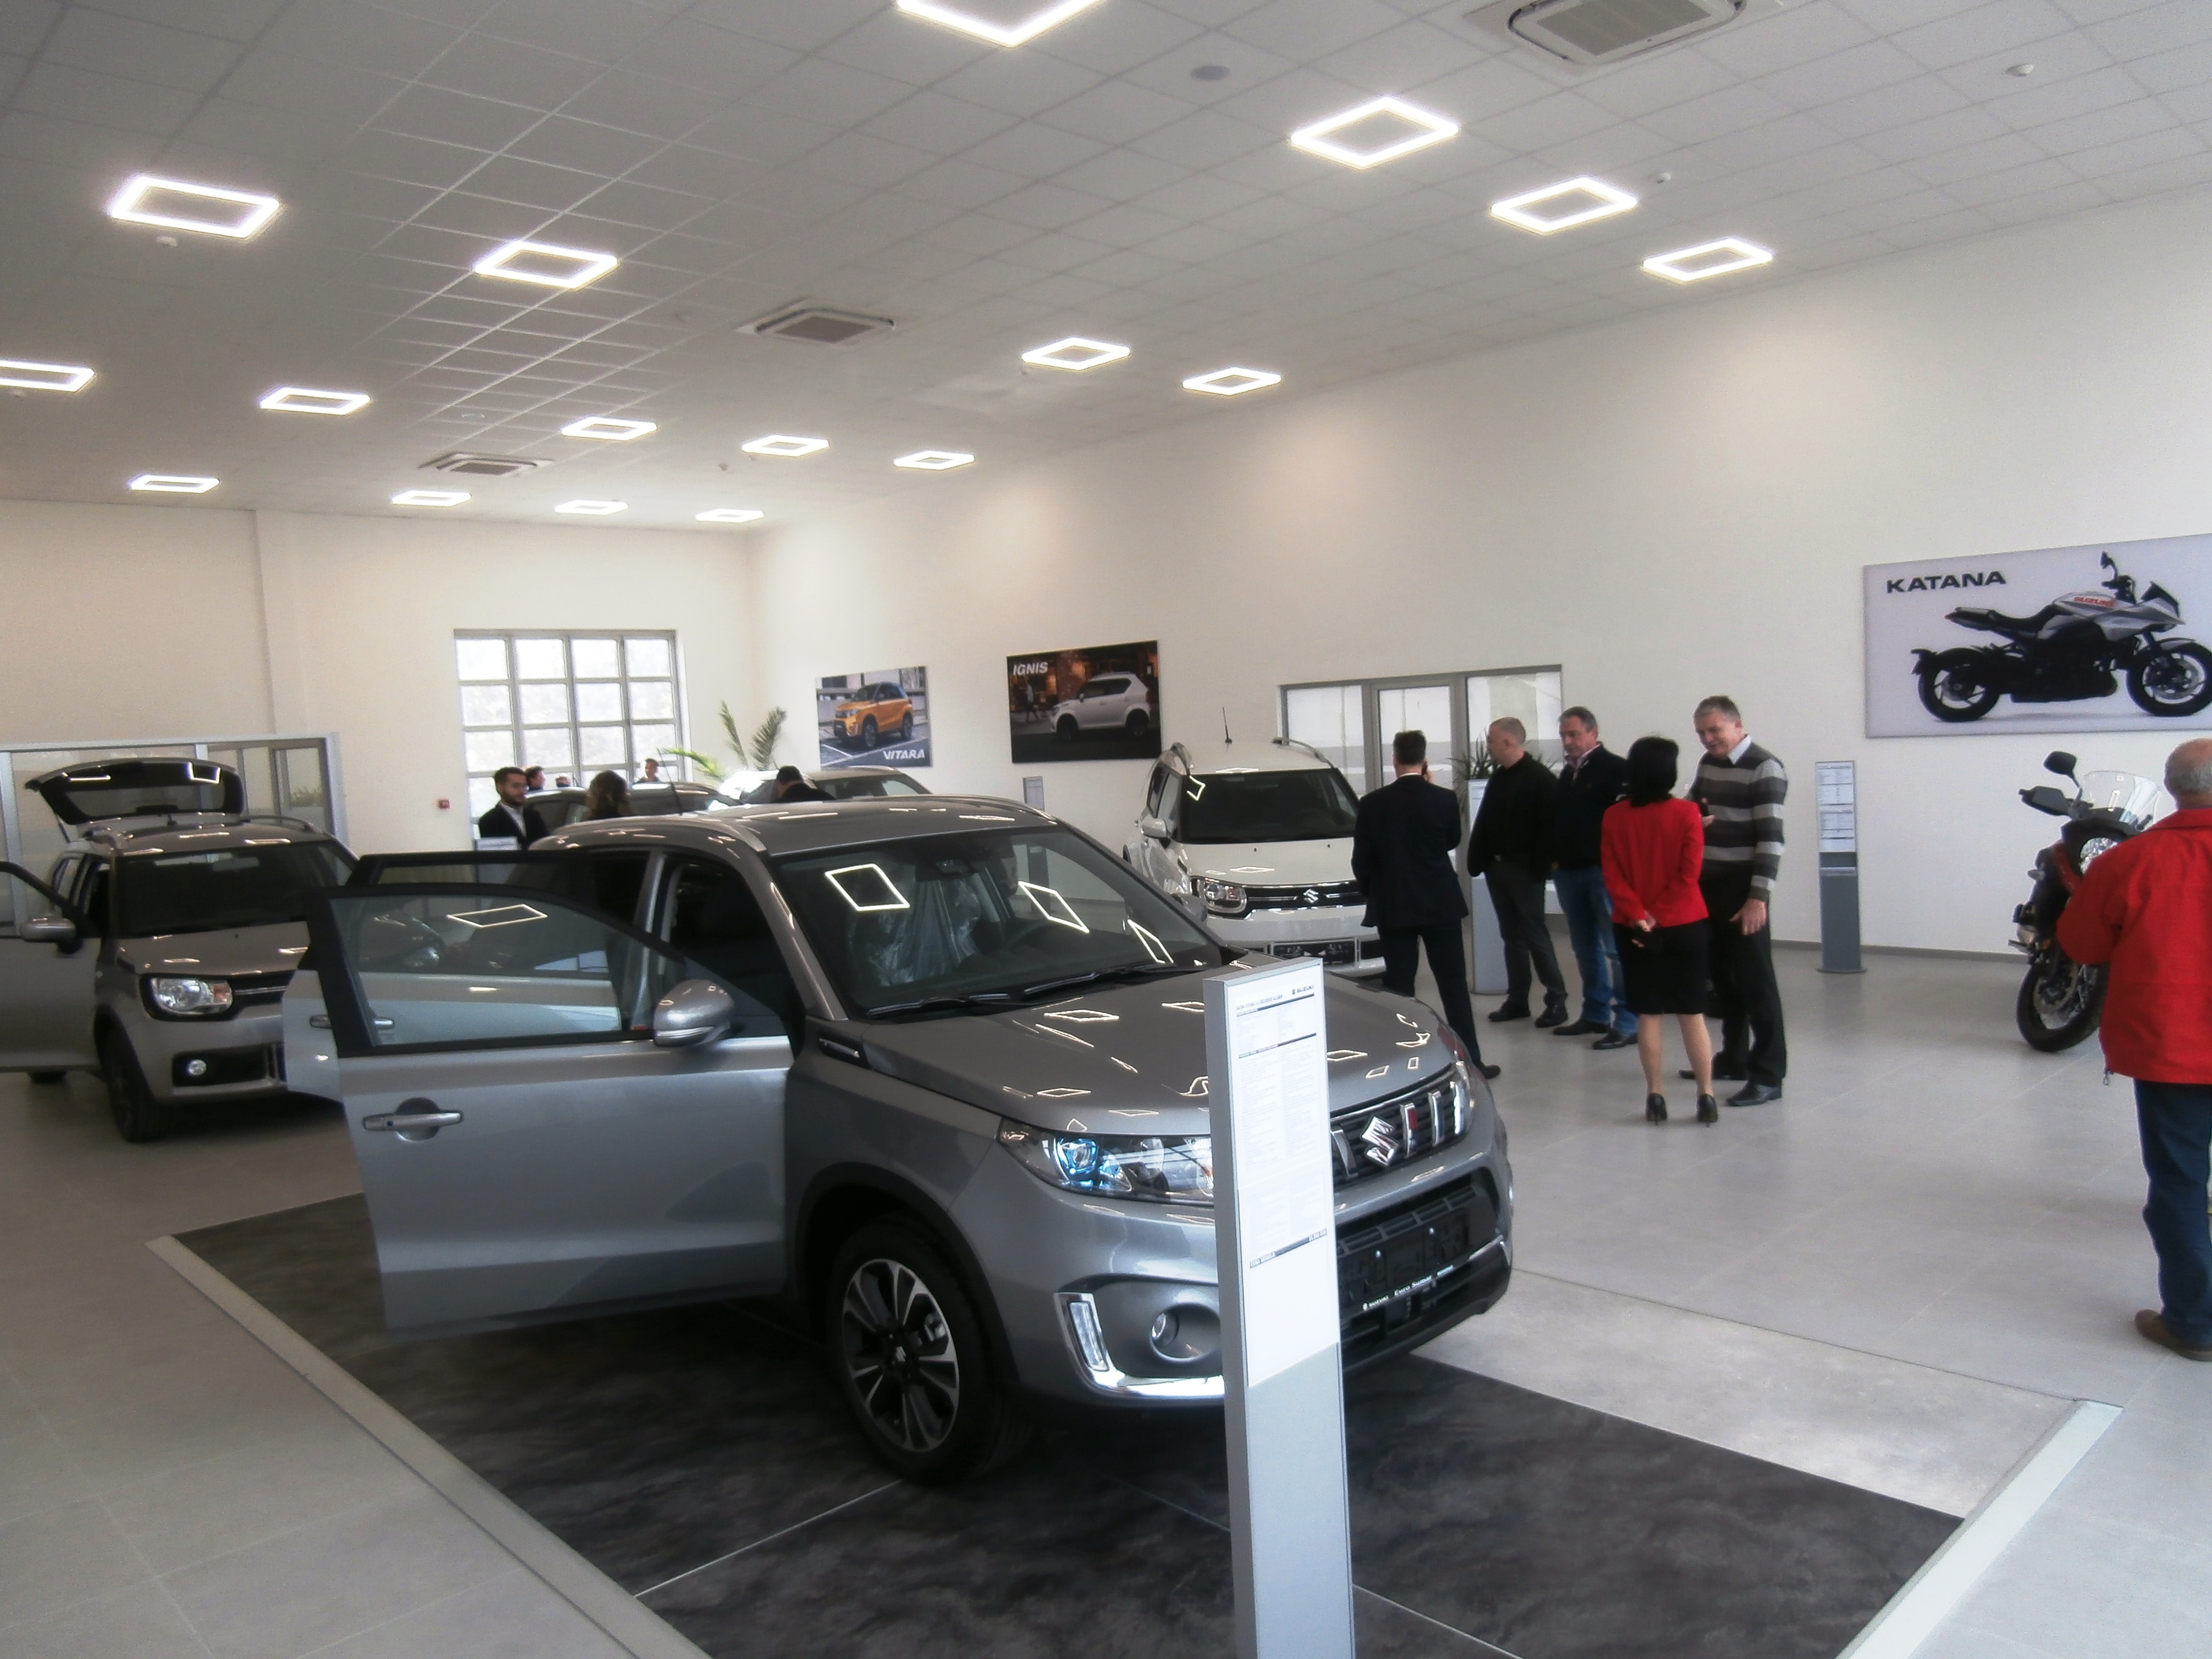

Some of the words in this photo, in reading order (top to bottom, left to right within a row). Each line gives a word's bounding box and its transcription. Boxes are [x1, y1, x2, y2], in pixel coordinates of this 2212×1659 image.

[1886, 570, 2007, 594] KATANA
[1012, 662, 1049, 676] IGNIS
[883, 749, 926, 760] VITARA
